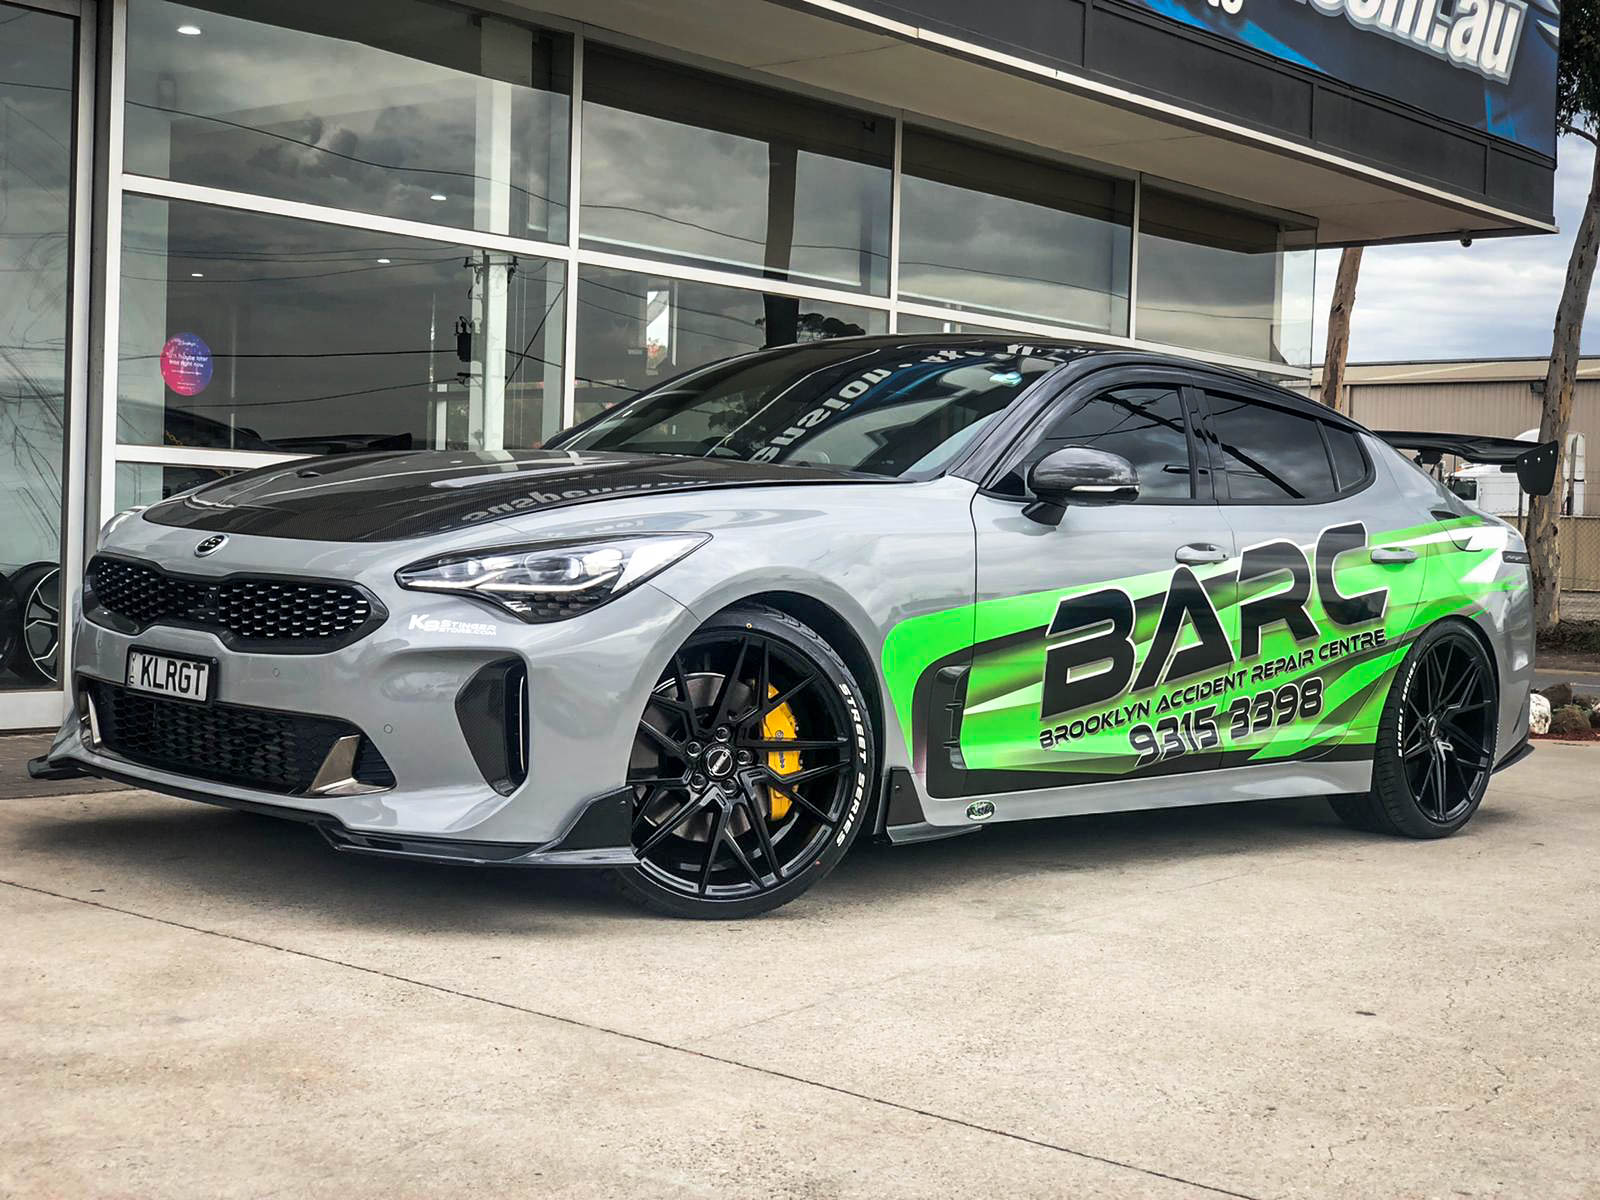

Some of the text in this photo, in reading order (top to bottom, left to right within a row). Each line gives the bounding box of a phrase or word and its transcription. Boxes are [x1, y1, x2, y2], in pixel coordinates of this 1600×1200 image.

[1311, 0, 1521, 74] m.au
[1039, 521, 1389, 721] BARC
[140, 655, 206, 696] KLRGT
[1039, 628, 1387, 751] BROOKLYN ACCIDENT REPAIR CENTRE
[1128, 676, 1324, 769] 9315 3398
[836, 683, 867, 847] STREET SERIES
